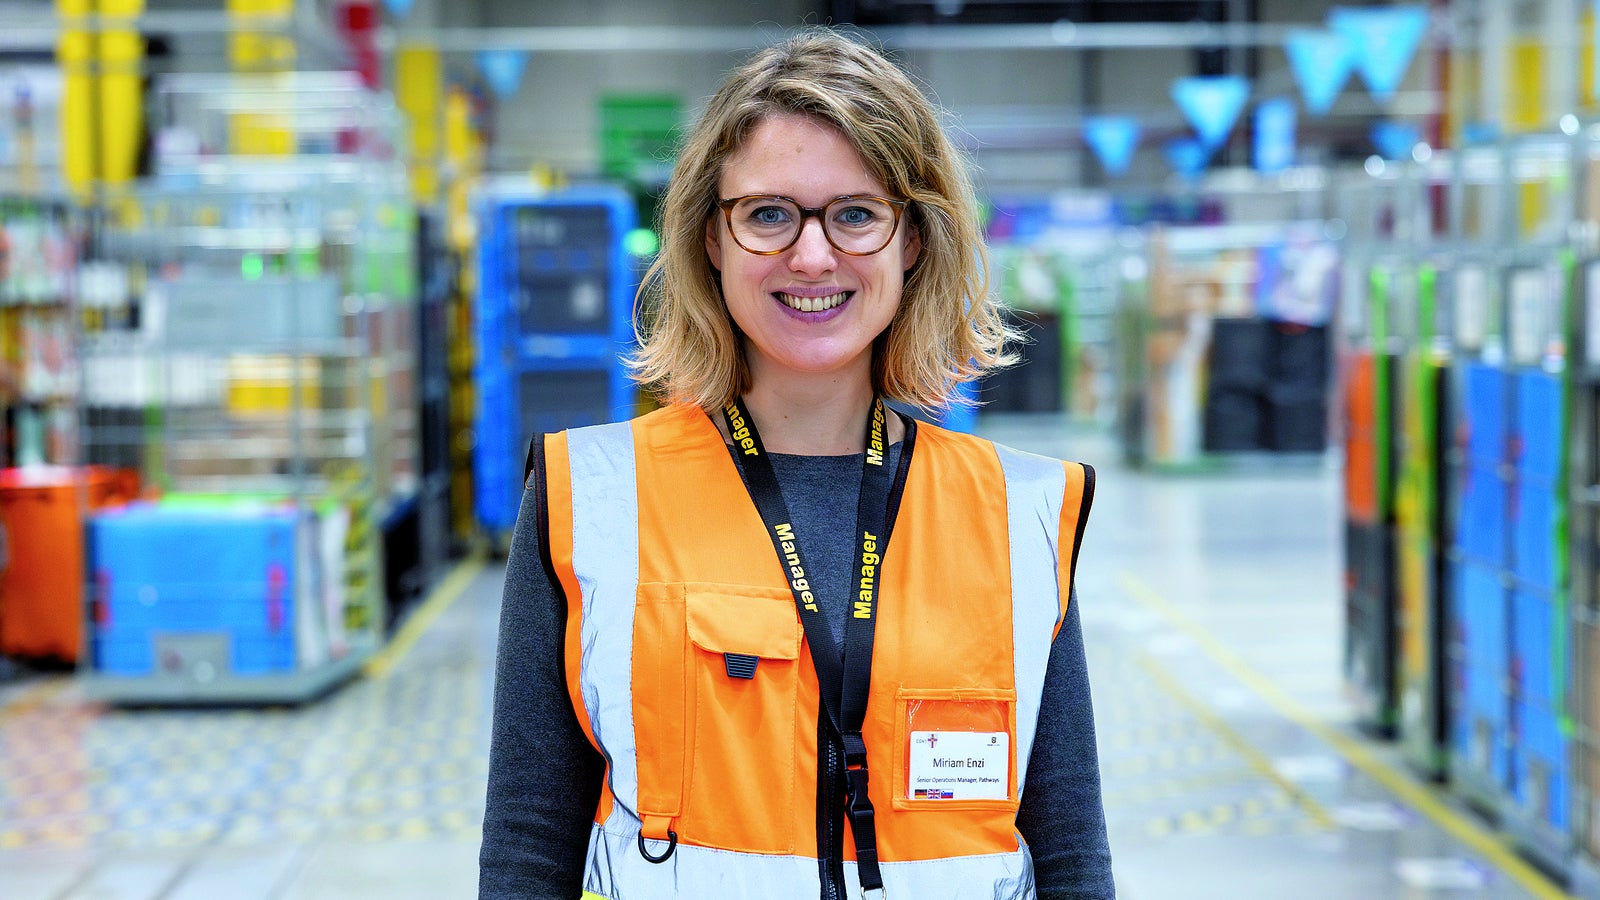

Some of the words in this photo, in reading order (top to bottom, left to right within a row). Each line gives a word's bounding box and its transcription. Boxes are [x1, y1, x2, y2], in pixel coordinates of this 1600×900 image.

[725, 400, 759, 456] anager
[866, 398, 885, 466] Manage
[774, 523, 818, 614] Manager
[854, 531, 880, 619] Manager
[933, 757, 964, 768] Miriam
[966, 757, 985, 768] Enzi
